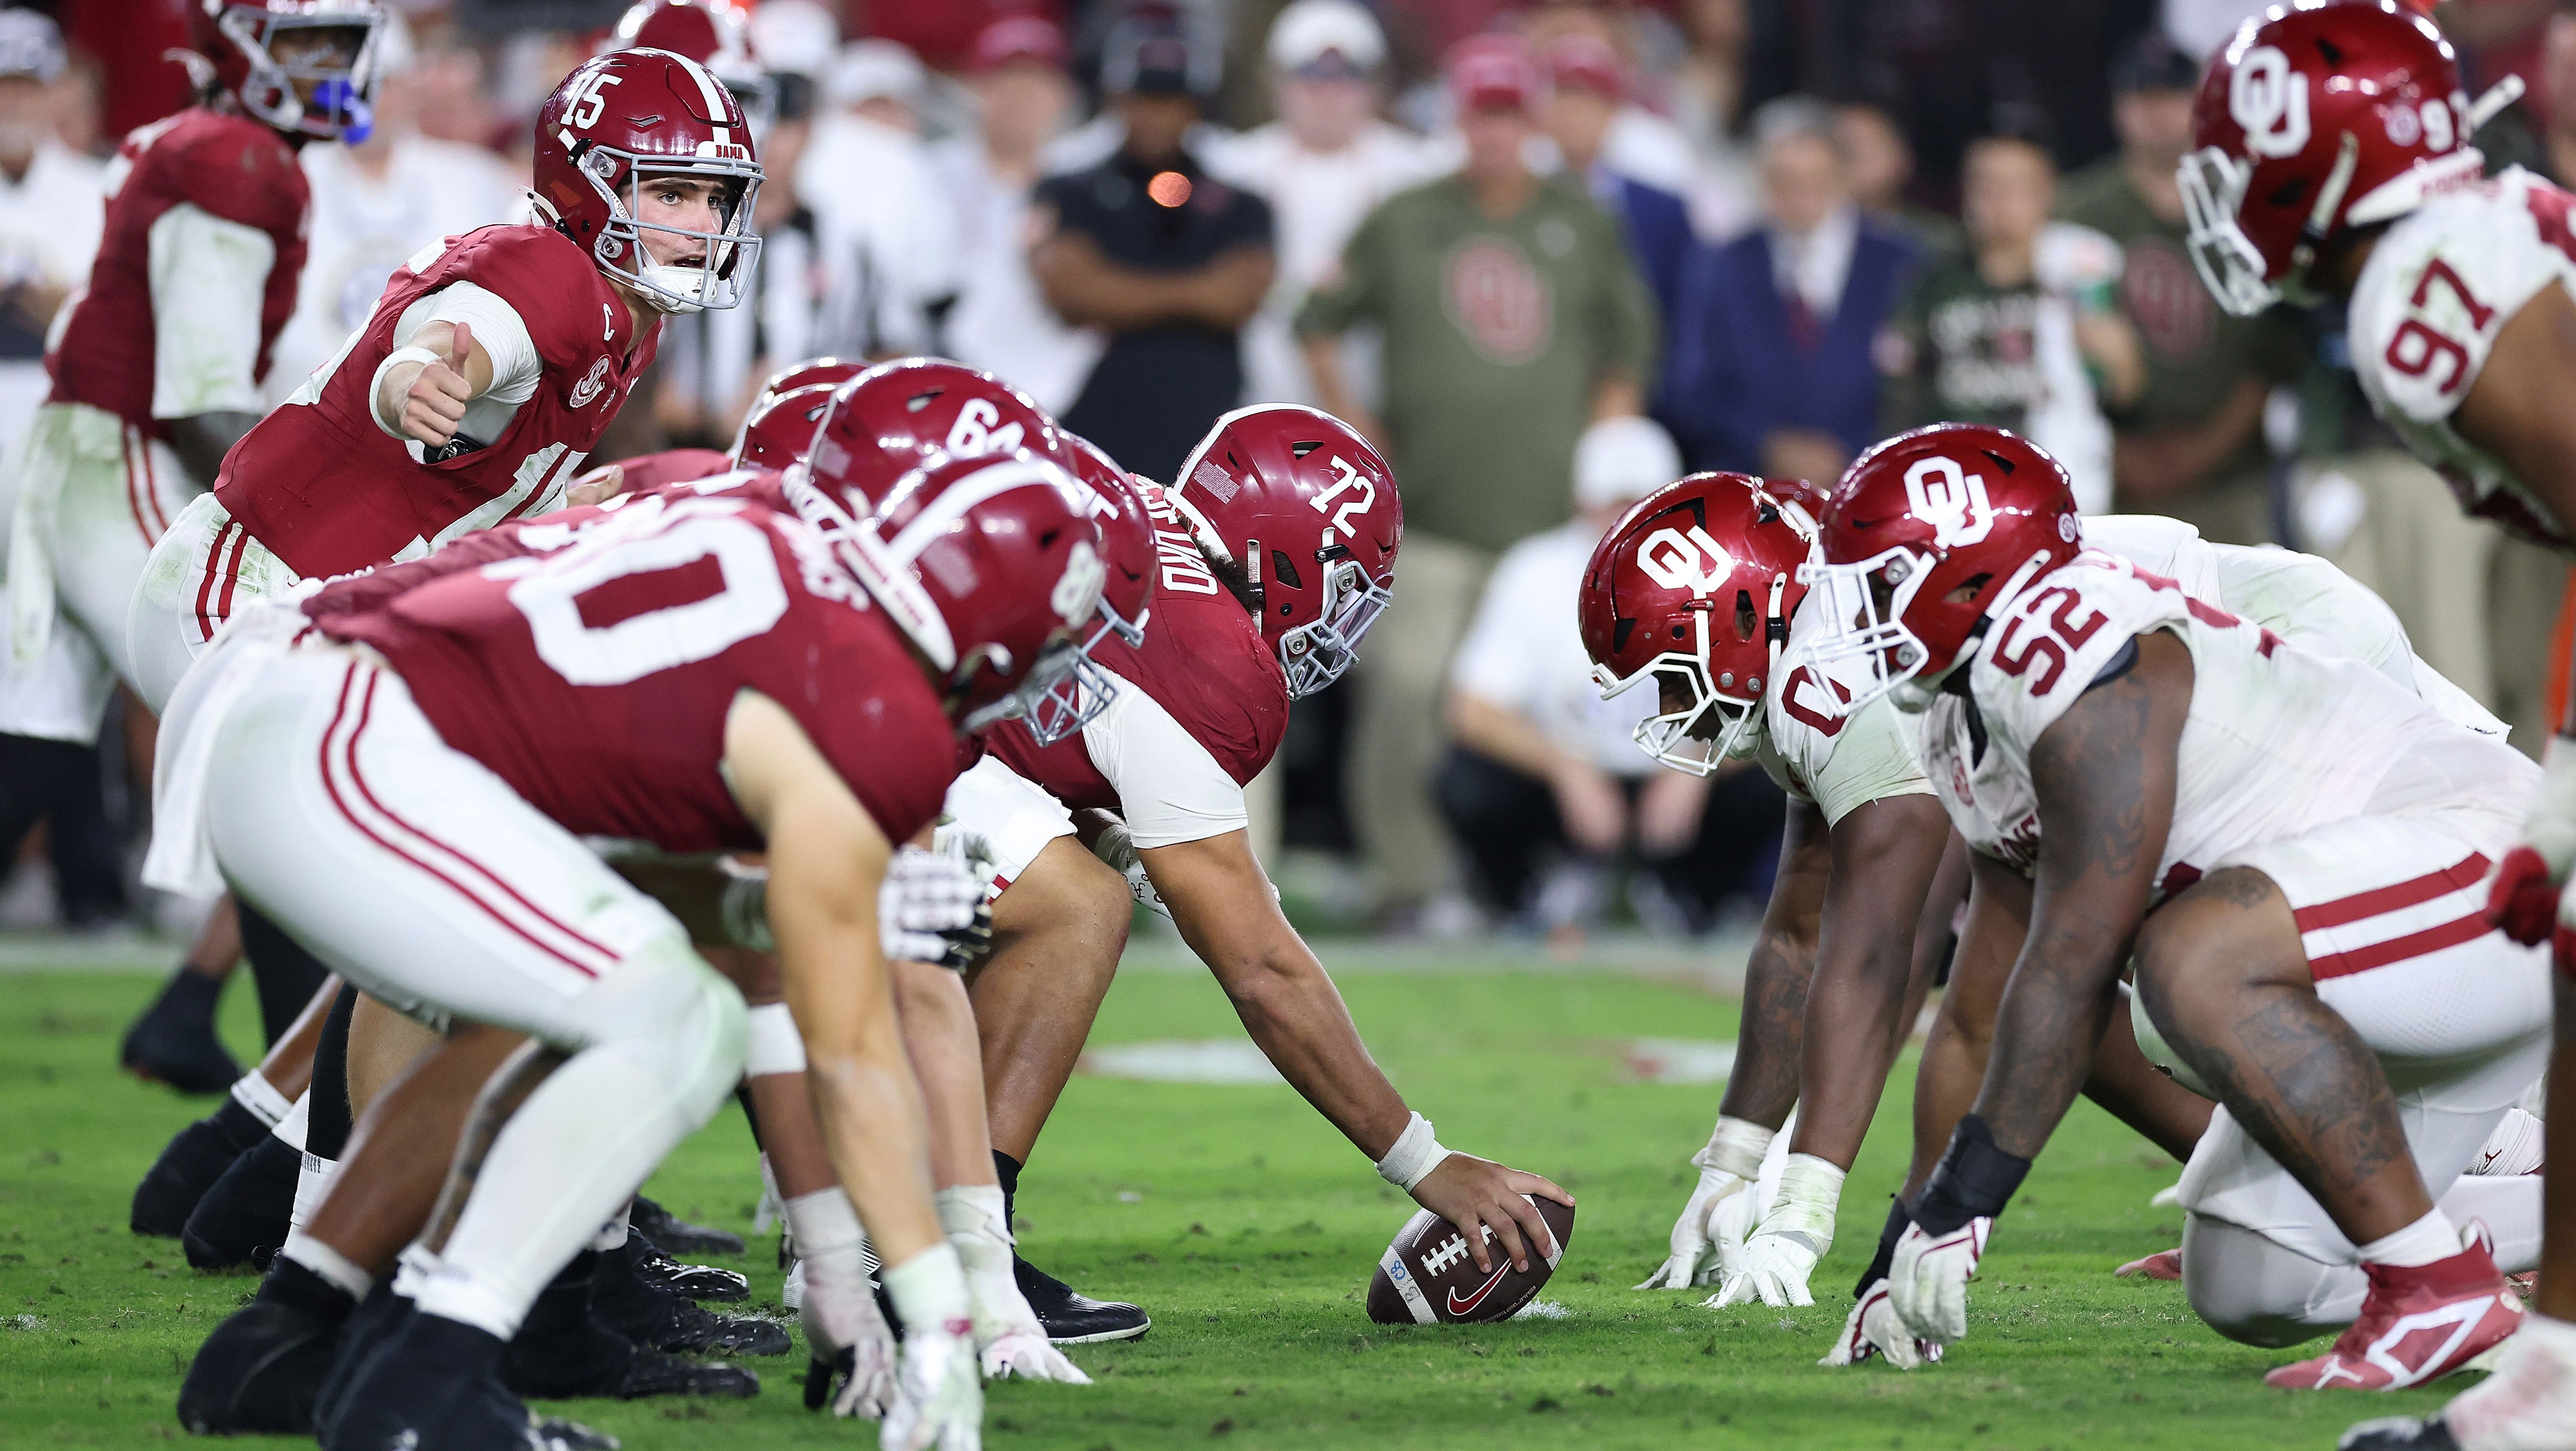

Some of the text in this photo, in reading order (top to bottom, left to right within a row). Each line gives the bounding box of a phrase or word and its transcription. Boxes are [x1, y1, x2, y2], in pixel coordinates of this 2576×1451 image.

[560, 71, 623, 130] 15
[2229, 44, 2311, 159] OU
[715, 144, 744, 160] BAMA
[2386, 257, 2496, 395] 97
[1309, 454, 1376, 539] 72
[1903, 455, 1994, 548] OU
[1637, 525, 1733, 593] OU
[1991, 586, 2109, 697] 52
[1782, 665, 1851, 737] 0
